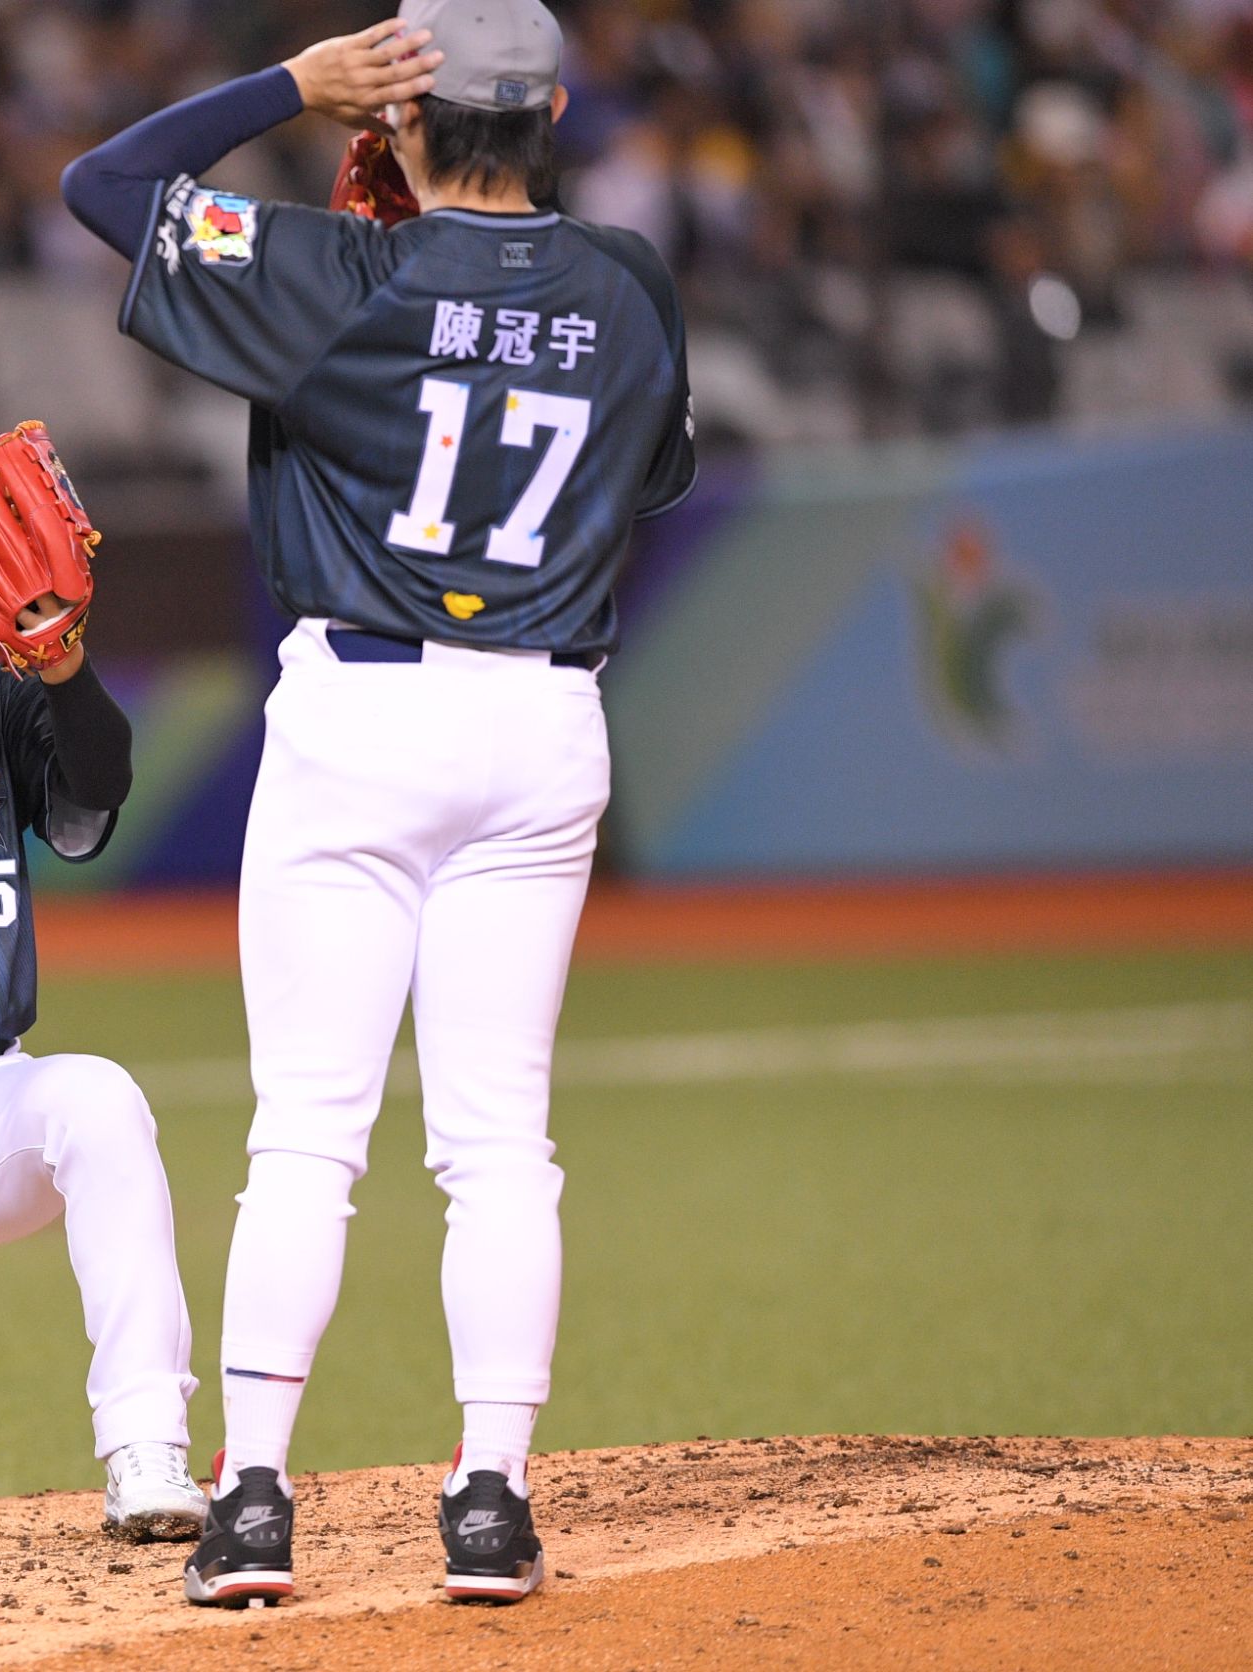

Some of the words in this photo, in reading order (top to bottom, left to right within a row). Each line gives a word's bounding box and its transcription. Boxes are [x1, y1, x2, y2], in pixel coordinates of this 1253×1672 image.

[428, 299, 597, 371] 陳冠宇
[385, 377, 592, 569] 17
[240, 1505, 274, 1522] NIKE
[464, 1509, 499, 1525] NIKE
[243, 1531, 279, 1542] AIR
[464, 1536, 500, 1548] AIR
